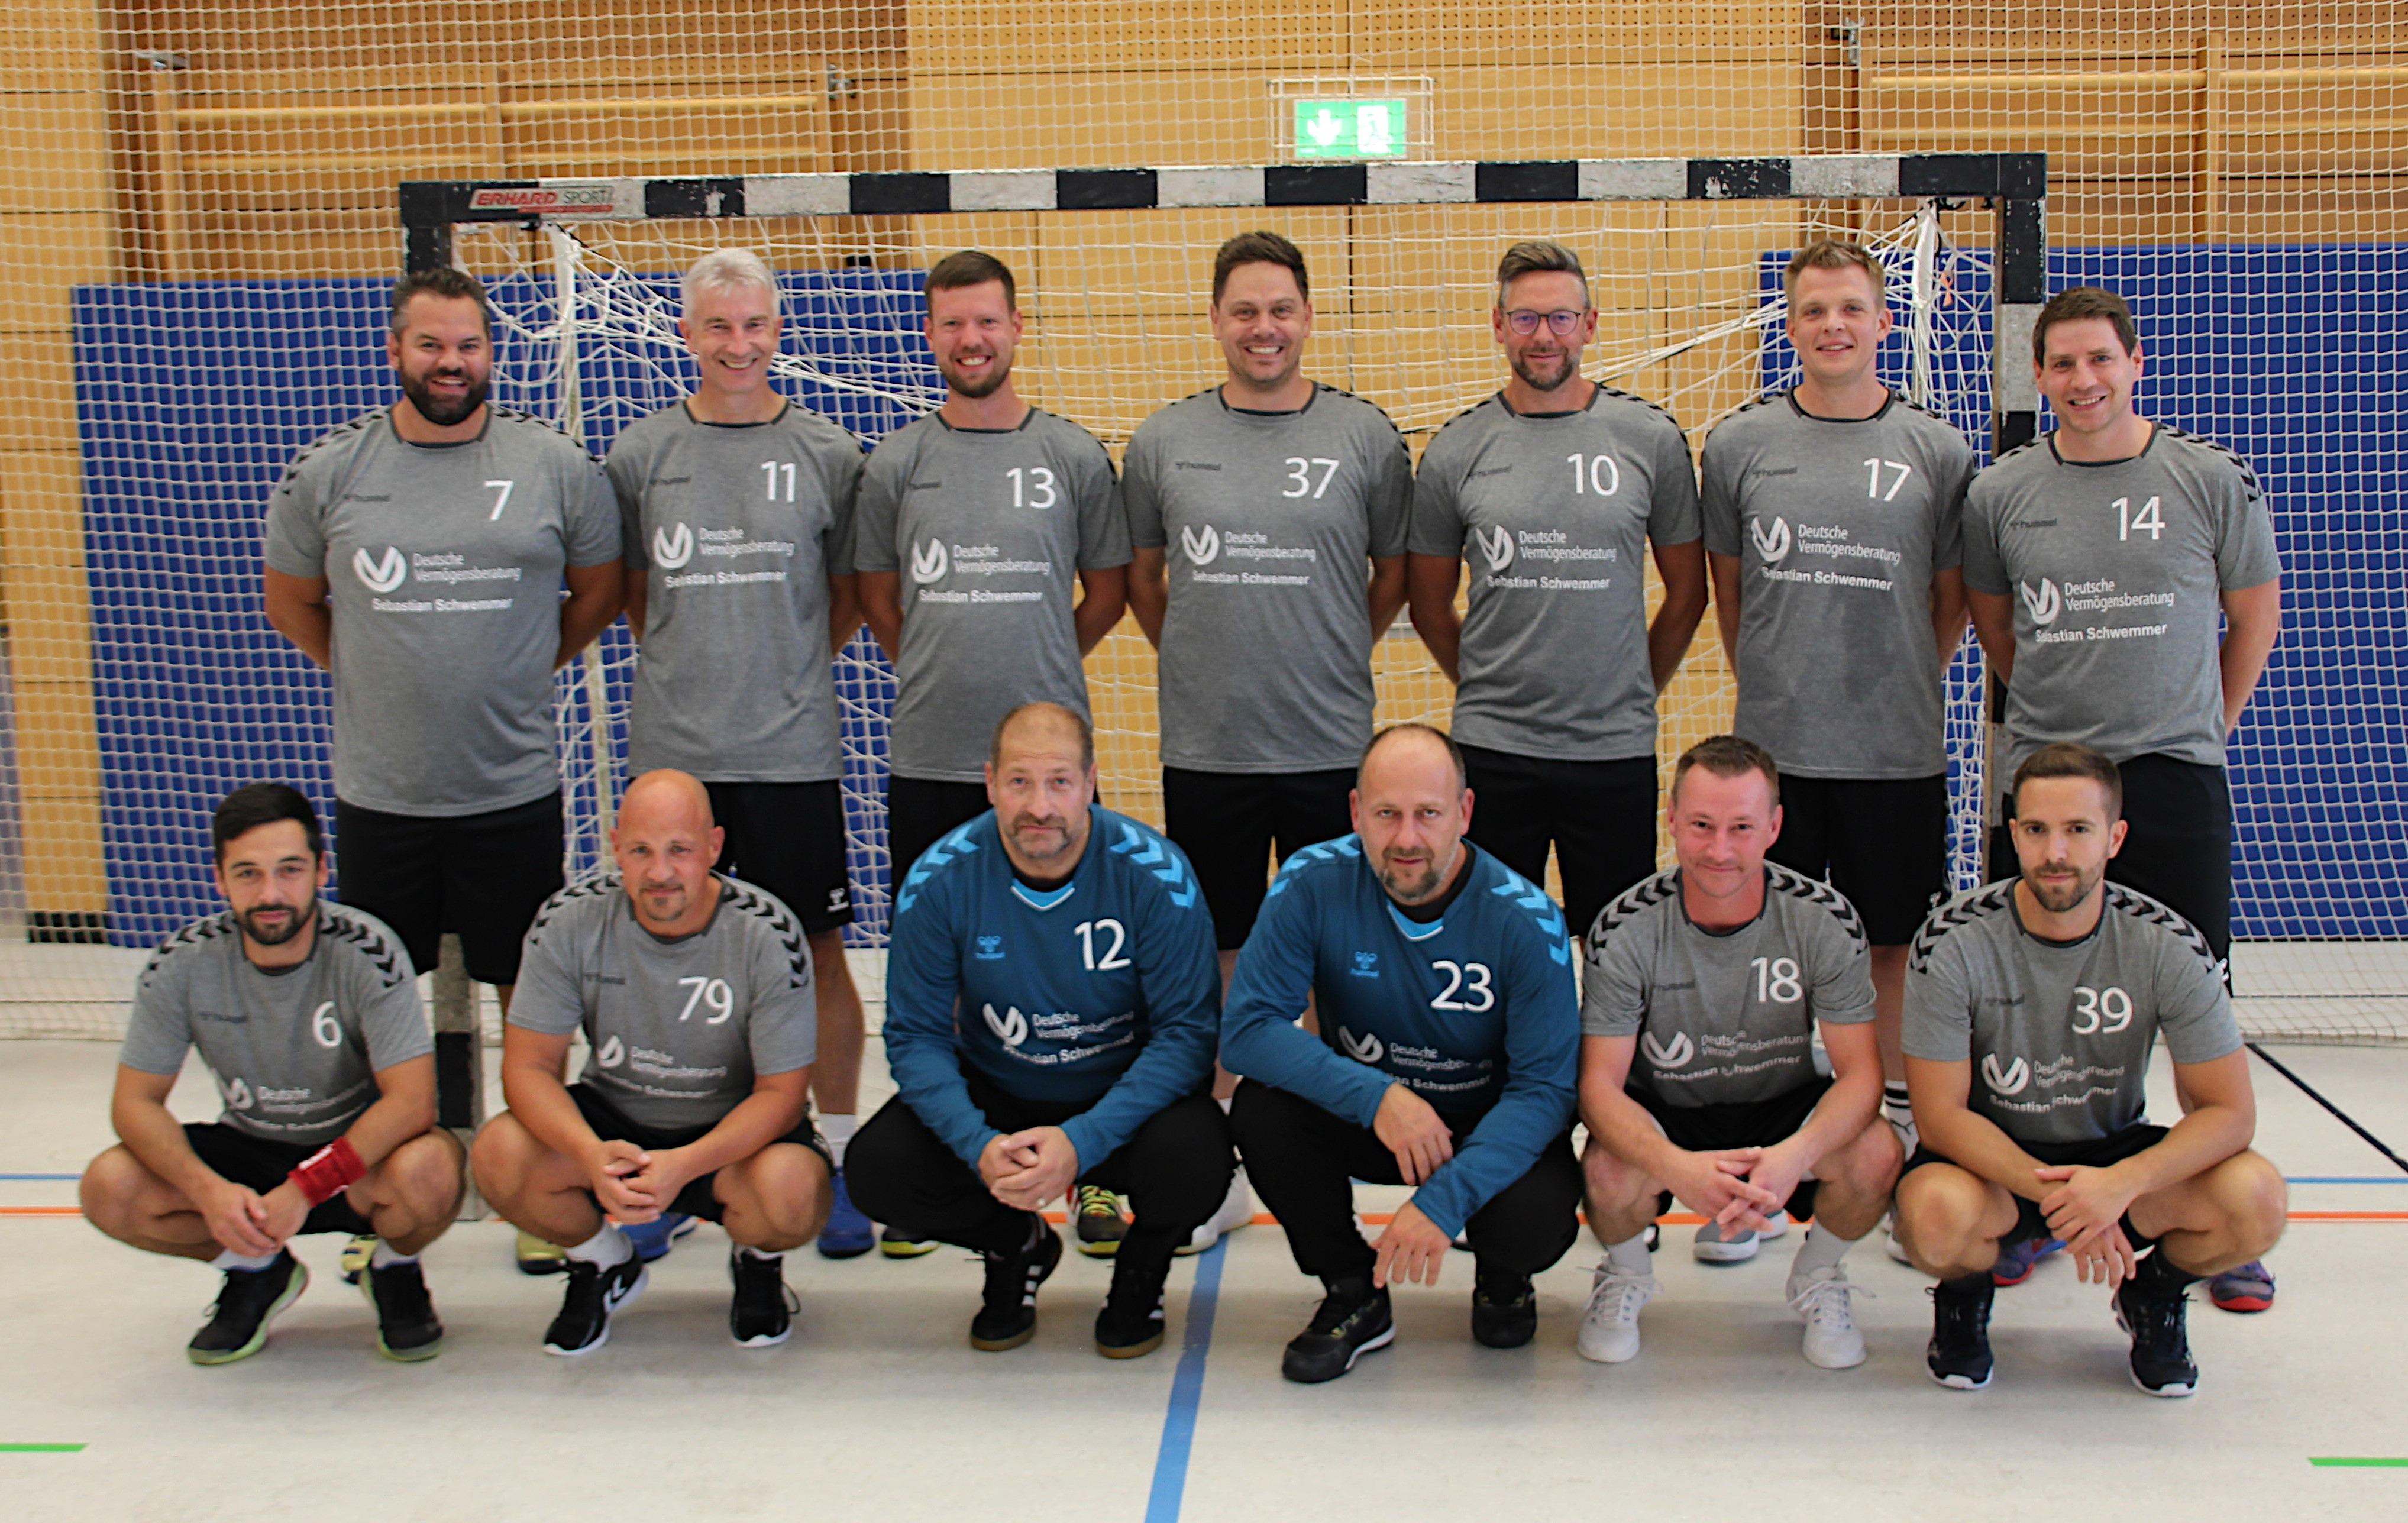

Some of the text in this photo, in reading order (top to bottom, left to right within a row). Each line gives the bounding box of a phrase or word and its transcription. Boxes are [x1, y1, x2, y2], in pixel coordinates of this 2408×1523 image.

[477, 189, 607, 205] ERHARD SPORT
[761, 461, 796, 502] 11
[1282, 457, 1340, 499] 37
[1567, 453, 1620, 497] 10
[1863, 458, 1911, 502] 17
[1006, 467, 1056, 509] 13
[483, 480, 515, 522] 7
[2111, 496, 2165, 541] 14
[699, 526, 745, 541] Deutsche
[1224, 530, 1268, 544] Deutsche
[1518, 528, 1567, 544] Deutsche
[1798, 523, 1848, 540] Deutsche
[412, 551, 465, 567] Deutsche
[952, 542, 1000, 557] Deutsche
[1225, 544, 1317, 562] Vermögensberatung
[1519, 544, 1618, 563] Vermögensberatung
[1798, 539, 1902, 566] Vermögensberatung
[716, 570, 788, 584] Schwemmer
[953, 557, 1051, 577] Vermögensberatung
[1240, 571, 1311, 585] Schwemmer
[1538, 575, 1611, 590] Schwemmer
[1814, 570, 1893, 591] Schwemmer
[2064, 577, 2115, 596] Deutsche
[969, 588, 1043, 602] Schwemmer
[2064, 591, 2175, 612] Vermögensberatung
[2086, 624, 2168, 640] Schwemmer
[1074, 918, 1132, 971] 12
[1431, 960, 1495, 1013] 23
[1751, 956, 1803, 1003] 18
[678, 976, 734, 1025] 79
[2072, 985, 2134, 1035] 39
[312, 1000, 343, 1049] 6
[1389, 1042, 1438, 1059] Deutsche
